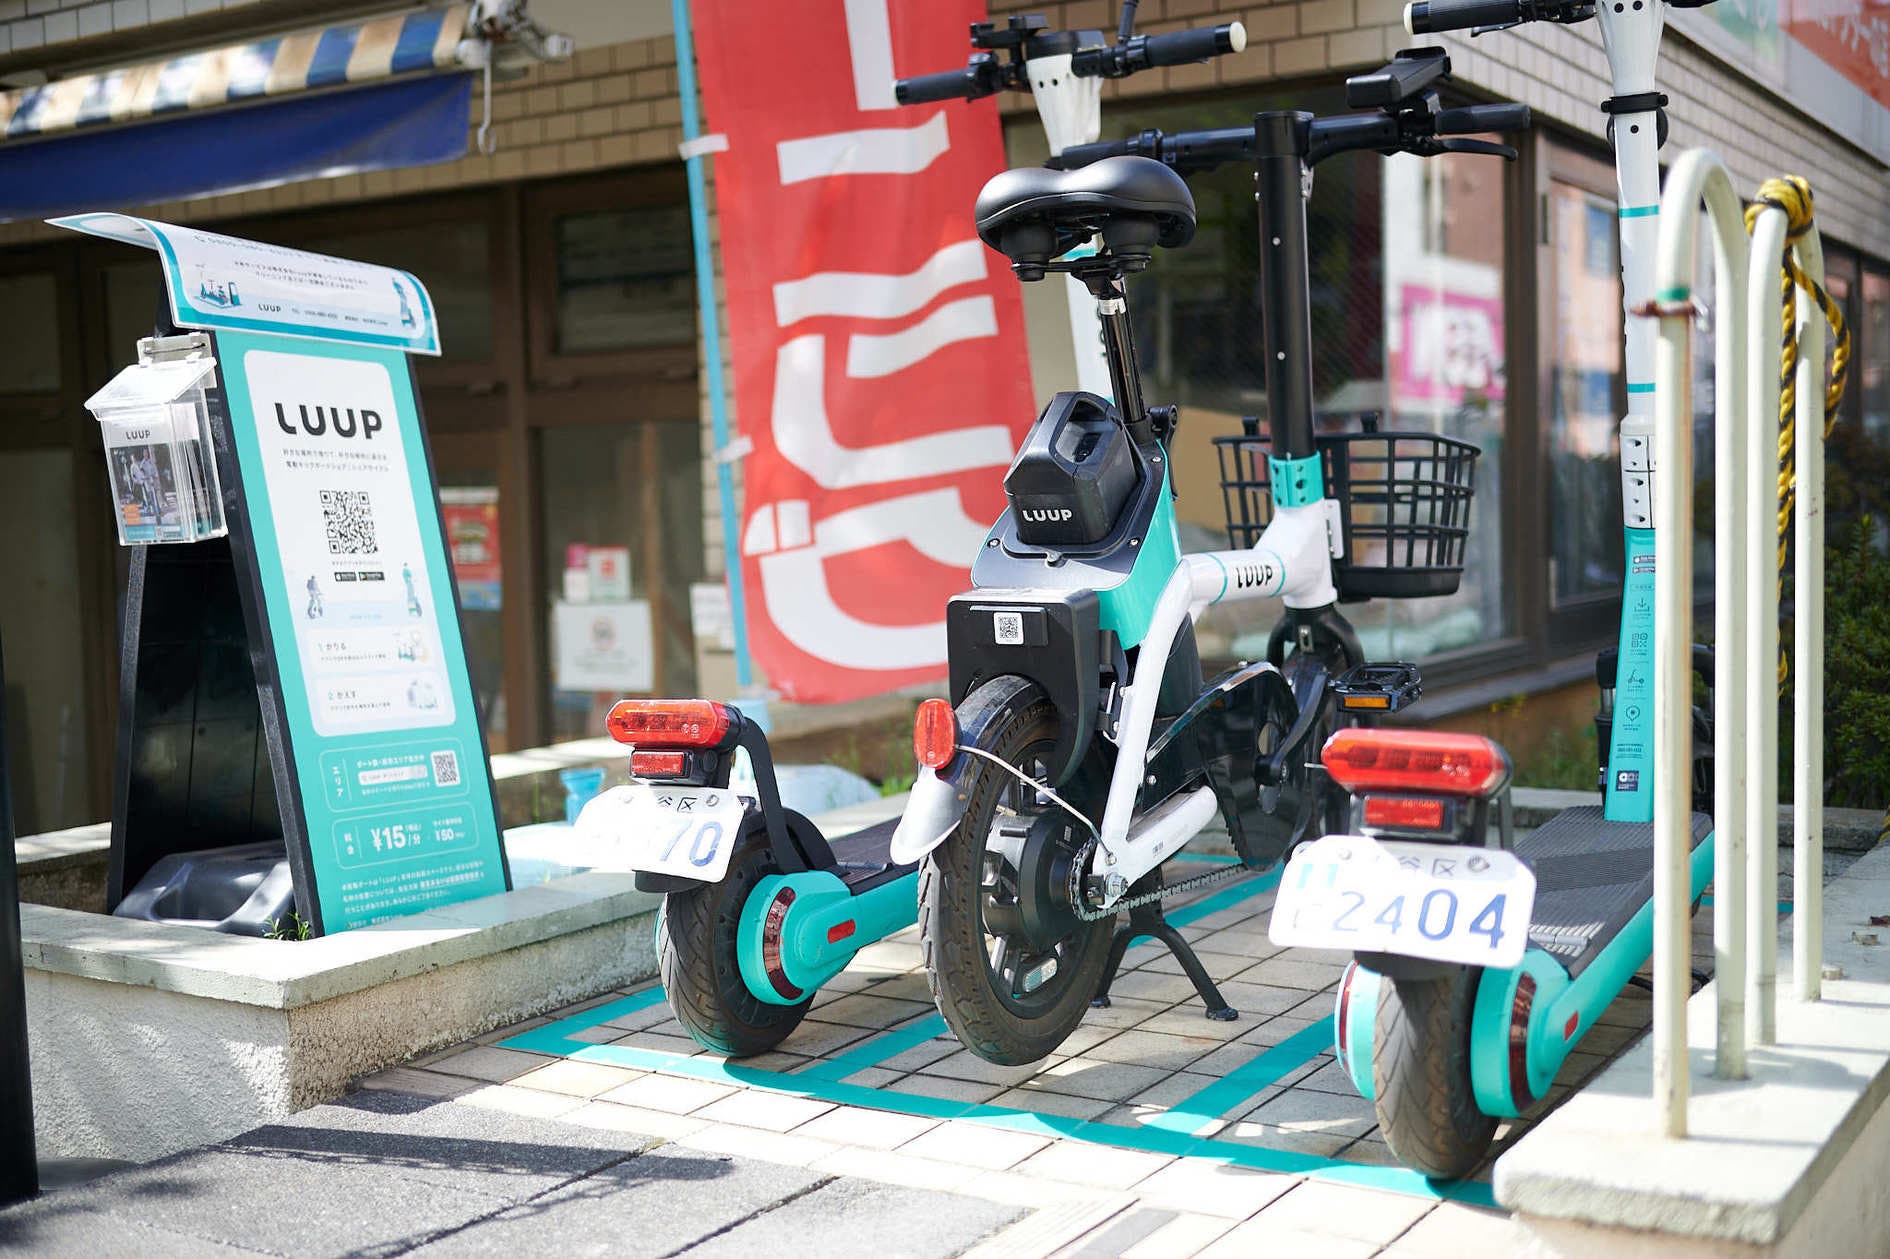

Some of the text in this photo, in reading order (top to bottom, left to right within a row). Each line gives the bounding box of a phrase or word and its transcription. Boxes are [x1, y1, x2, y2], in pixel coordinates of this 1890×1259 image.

[257, 303, 282, 313] LUUP
[274, 402, 383, 440] LUUP
[125, 430, 151, 440] LUUP
[1022, 507, 1073, 522] LUUP
[1236, 565, 1274, 588] LUUP
